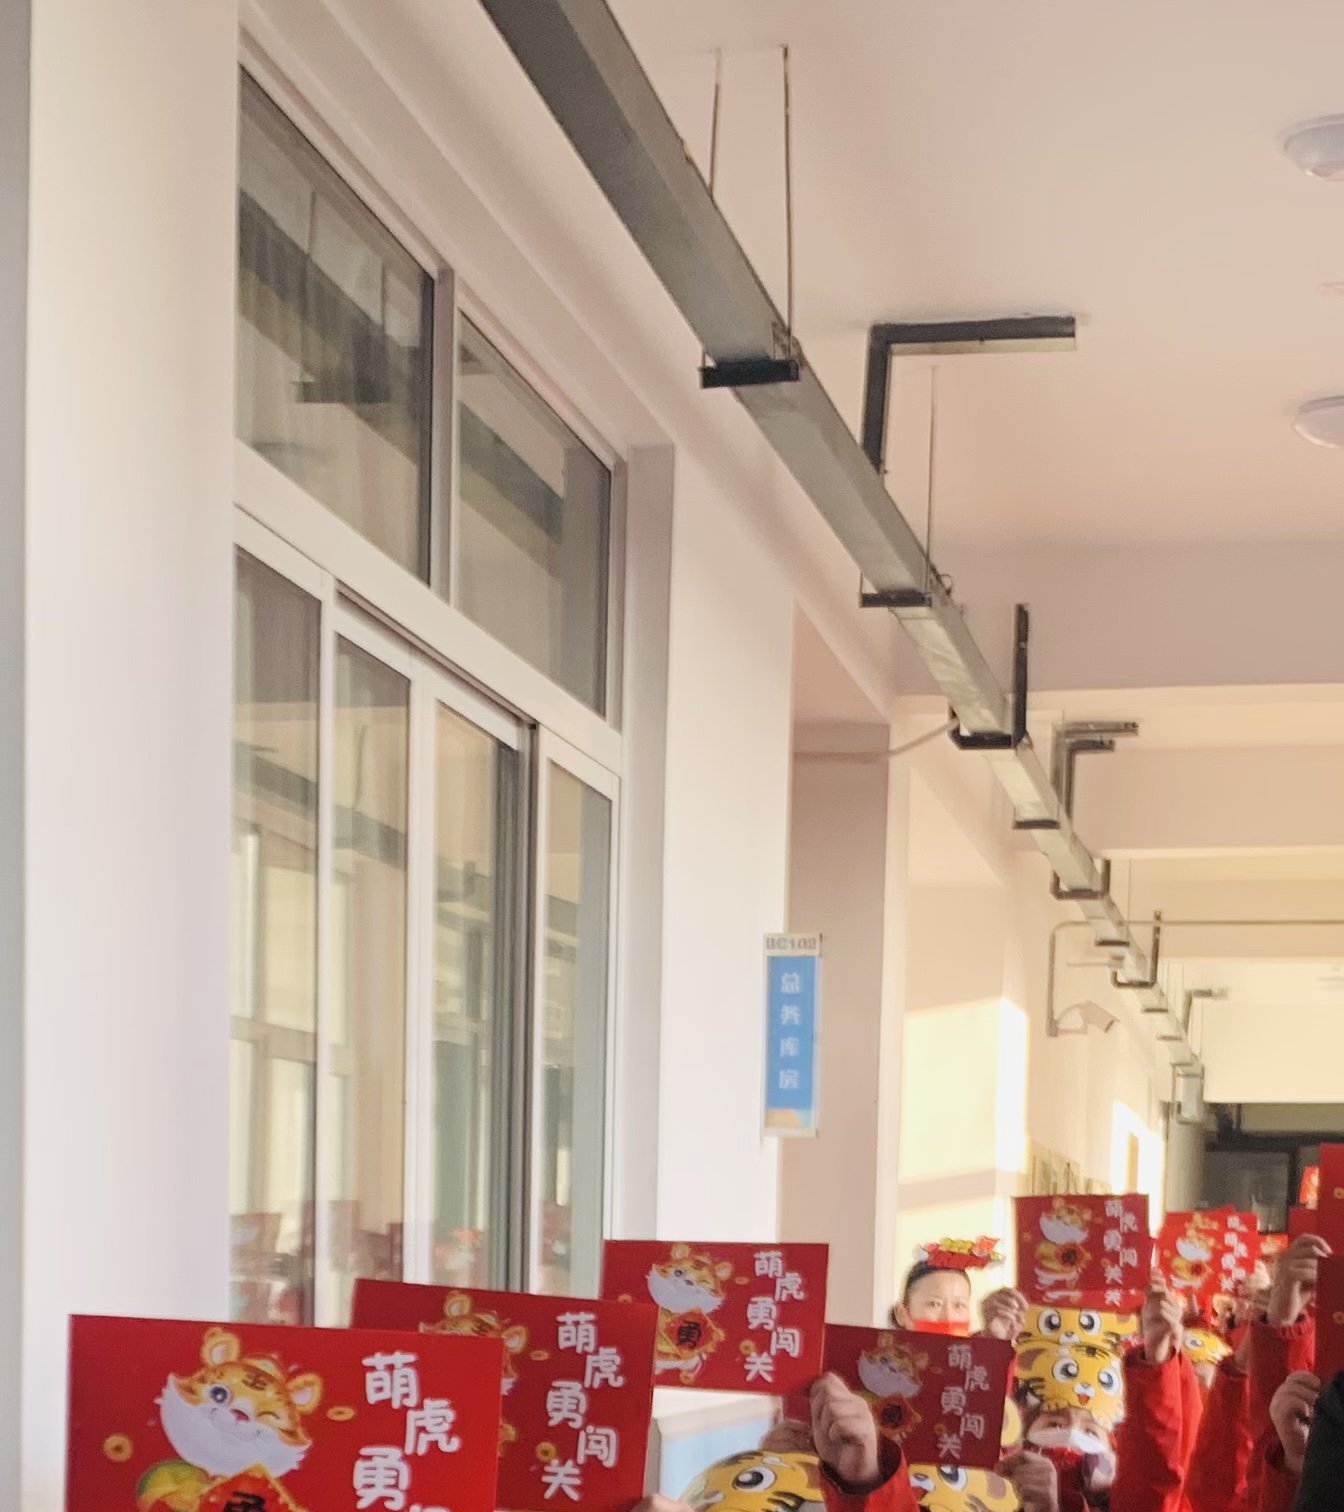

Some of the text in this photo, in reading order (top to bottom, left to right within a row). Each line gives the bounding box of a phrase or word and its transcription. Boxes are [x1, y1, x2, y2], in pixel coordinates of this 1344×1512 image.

[542, 1311, 624, 1501] 萌虎勇闯关
